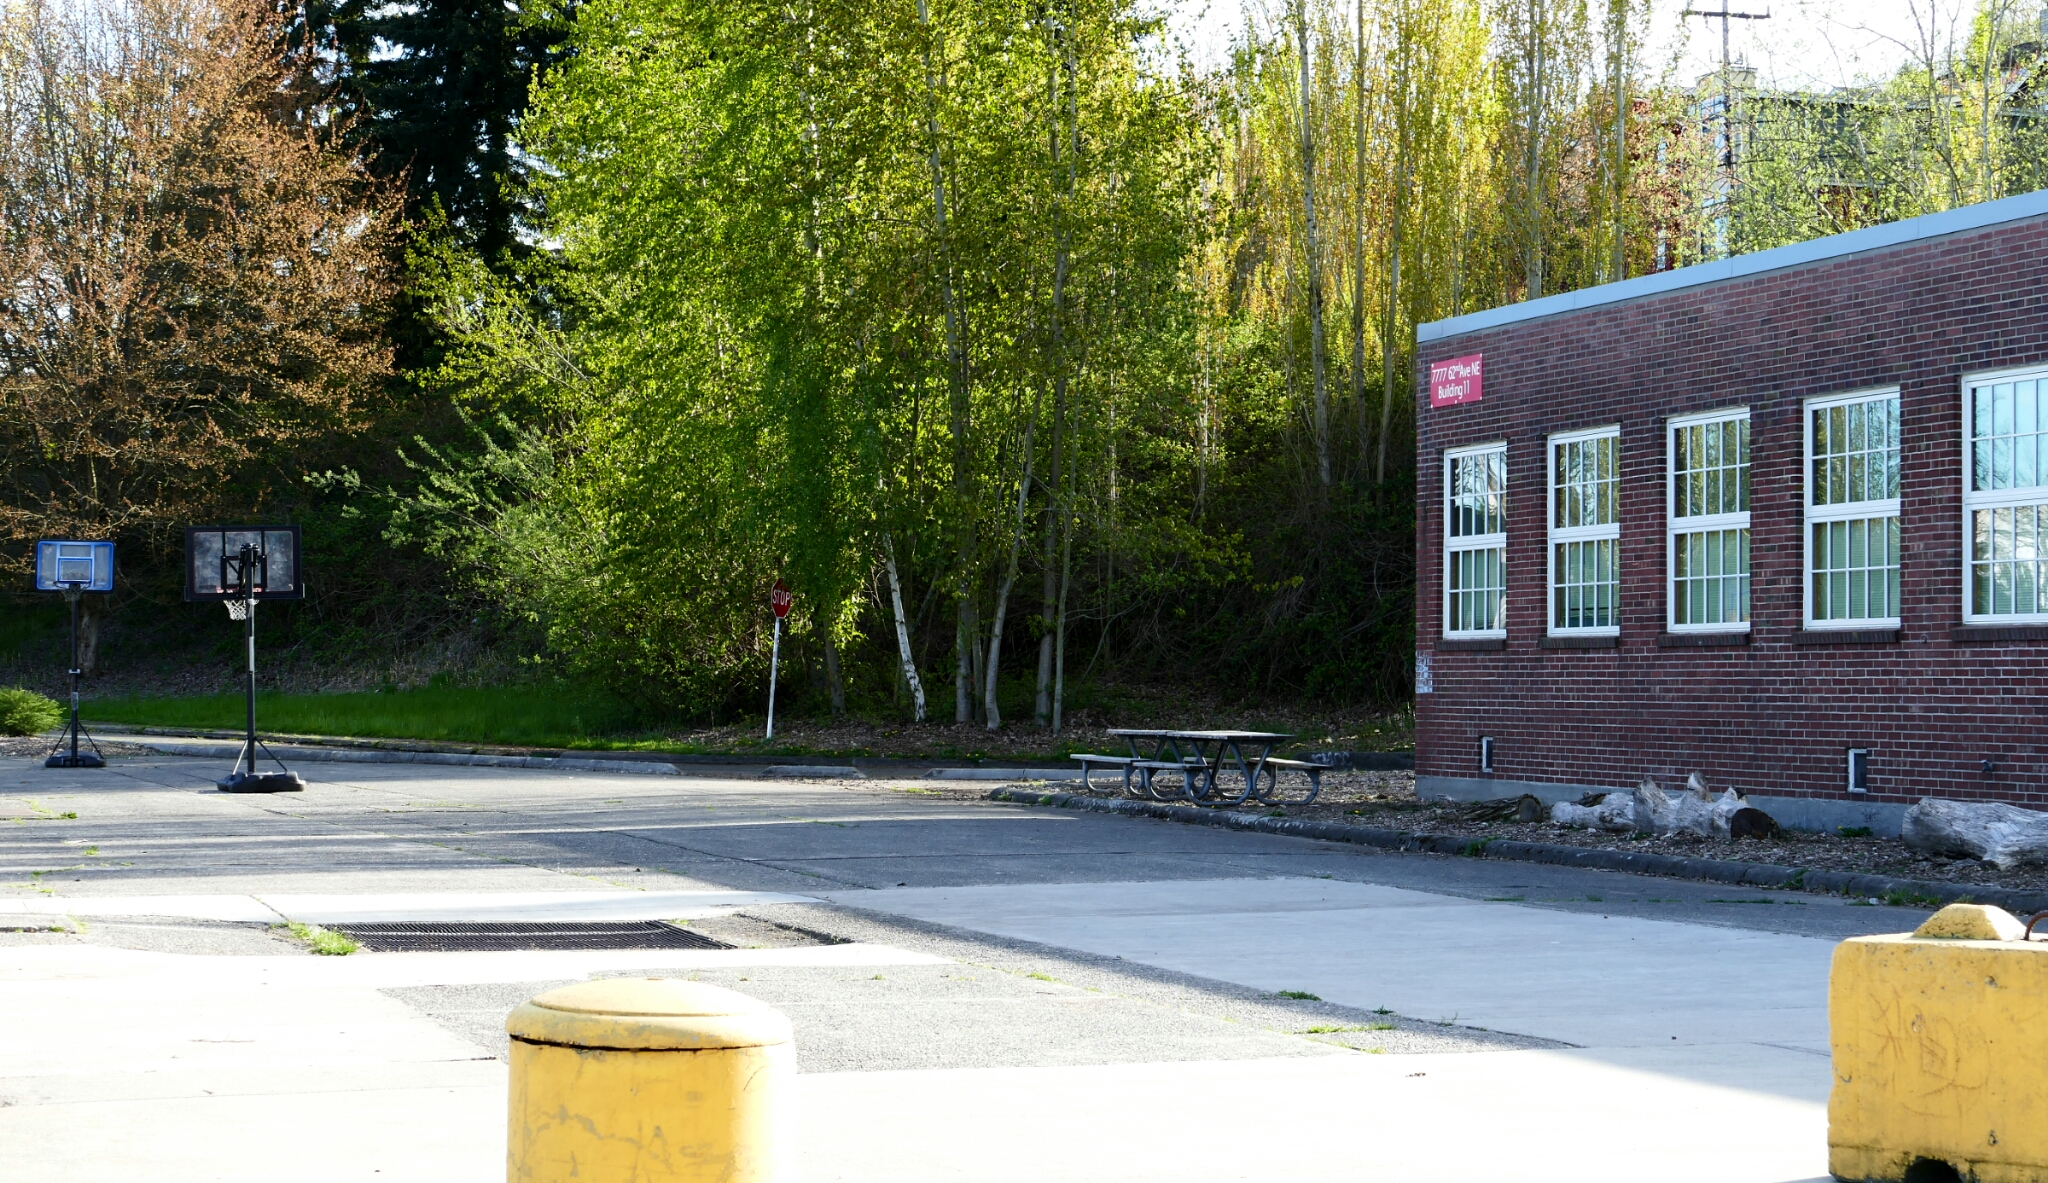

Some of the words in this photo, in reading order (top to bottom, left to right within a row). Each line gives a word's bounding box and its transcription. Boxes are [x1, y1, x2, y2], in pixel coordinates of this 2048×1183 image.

[1432, 367, 1448, 383] 7777
[1459, 364, 1471, 378] Ave
[1472, 361, 1480, 376] NE
[1438, 383, 1463, 399] Building
[1463, 380, 1470, 394] 11
[772, 589, 791, 606] STOP
